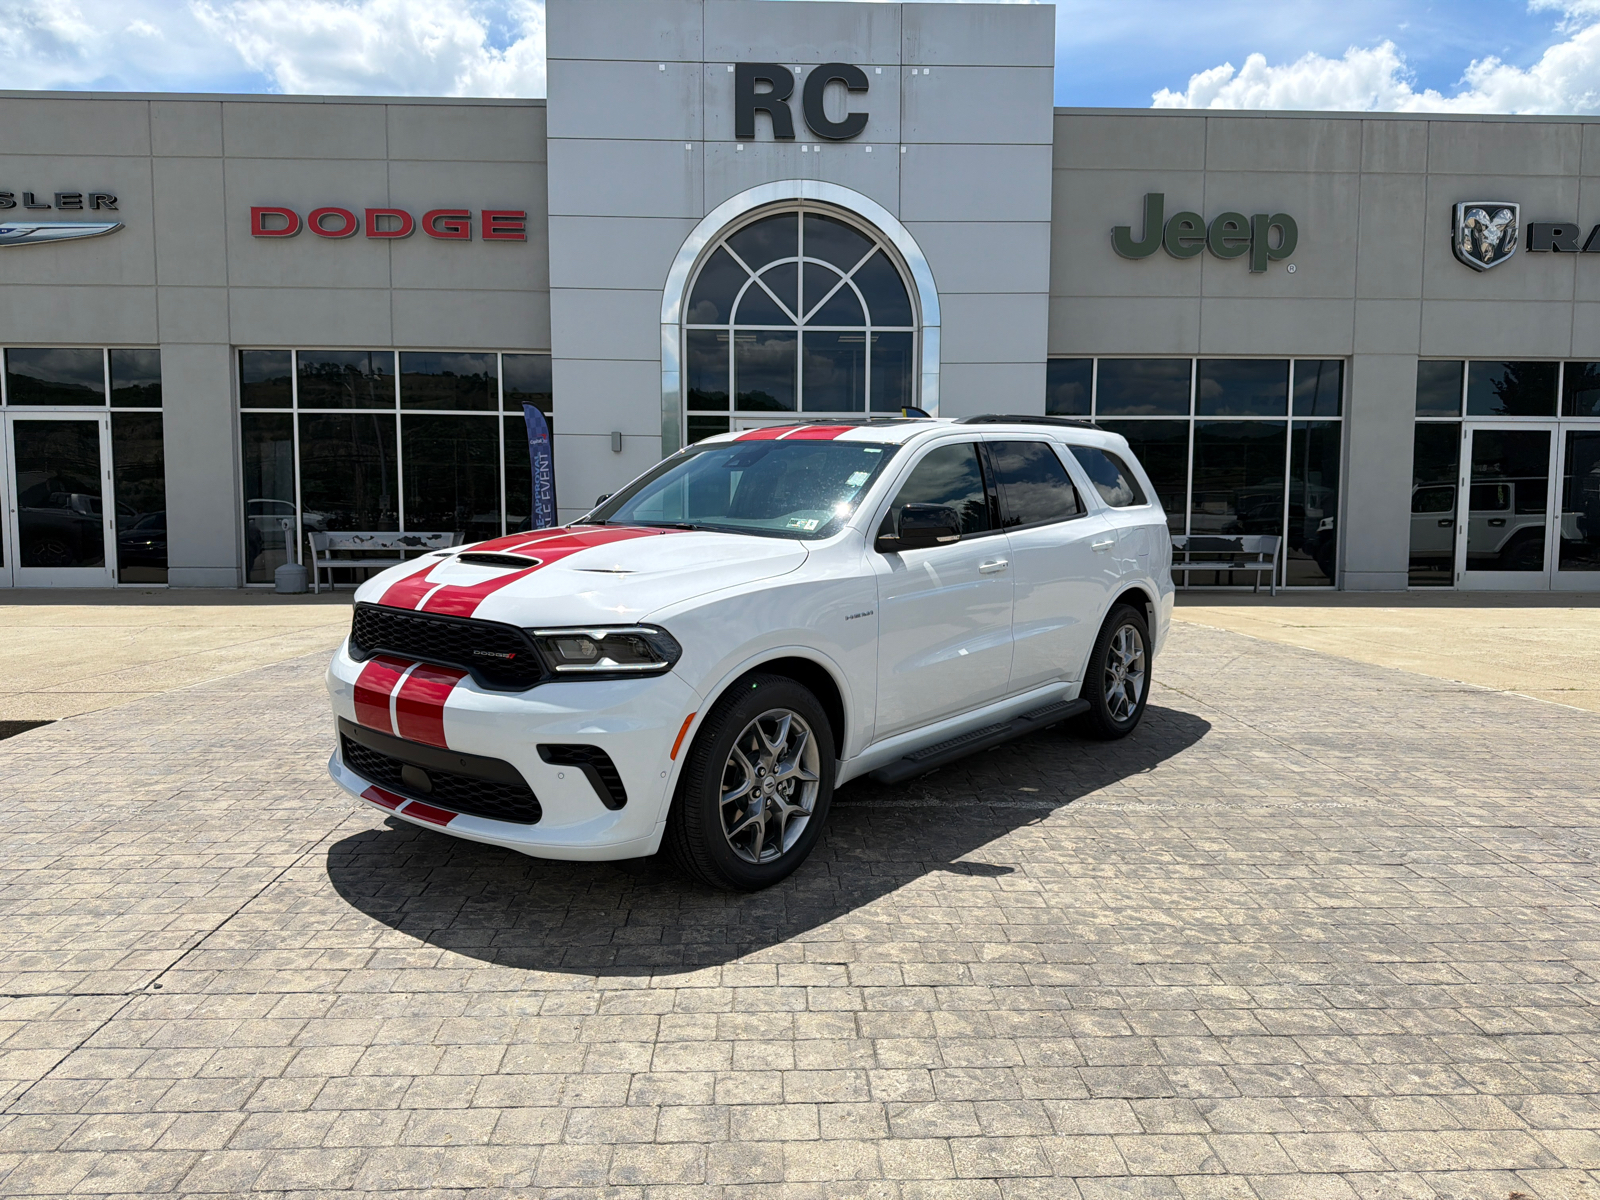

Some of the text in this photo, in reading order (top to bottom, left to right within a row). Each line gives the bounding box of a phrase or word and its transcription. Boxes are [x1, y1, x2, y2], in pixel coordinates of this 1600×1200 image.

[735, 62, 869, 141] RC
[250, 206, 527, 242] DODGE
[1111, 193, 1298, 273] Jeep
[540, 454, 551, 500] EVENT
[473, 650, 510, 658] DODGE
